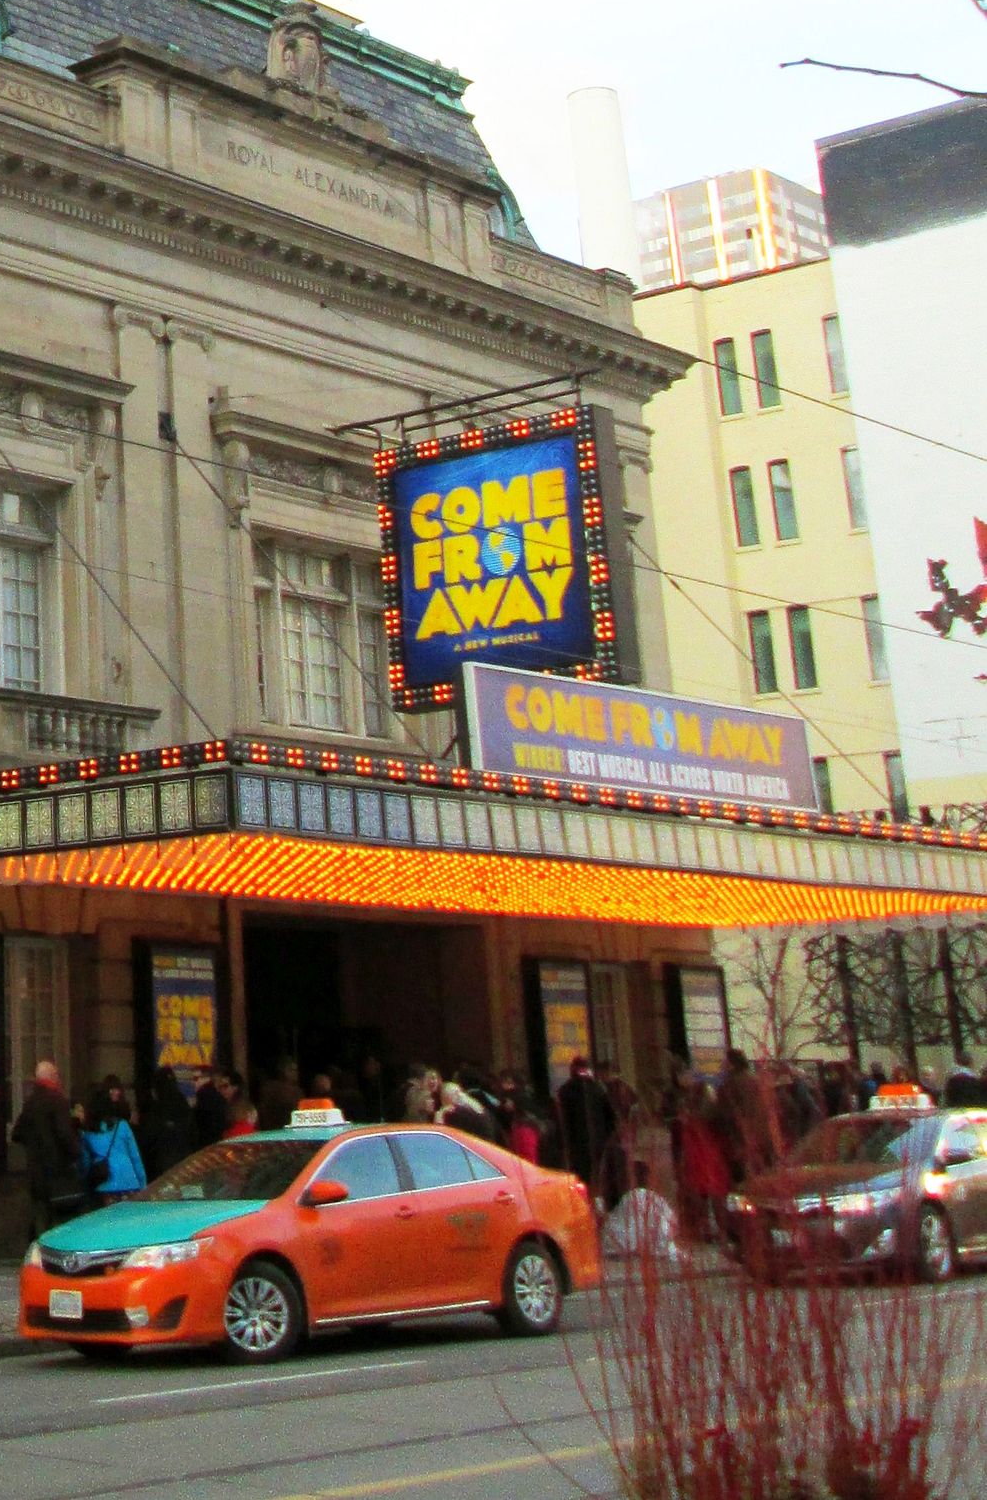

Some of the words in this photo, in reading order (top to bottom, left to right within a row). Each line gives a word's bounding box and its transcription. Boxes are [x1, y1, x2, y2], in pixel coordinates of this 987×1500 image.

[227, 140, 281, 177] ROYAL
[295, 165, 395, 219] ALEXANDRA
[410, 467, 567, 540] COME
[413, 515, 573, 591] FROM
[416, 565, 574, 641] AWAY
[453, 642, 462, 652] A
[464, 638, 489, 651] NEW
[491, 630, 540, 646] MUSICAL
[505, 683, 607, 743] COME
[610, 700, 704, 757] FROM
[708, 718, 784, 767] AWAY
[566, 749, 598, 776] BEST
[597, 753, 649, 784] MUSICAL
[649, 760, 670, 787] ALL
